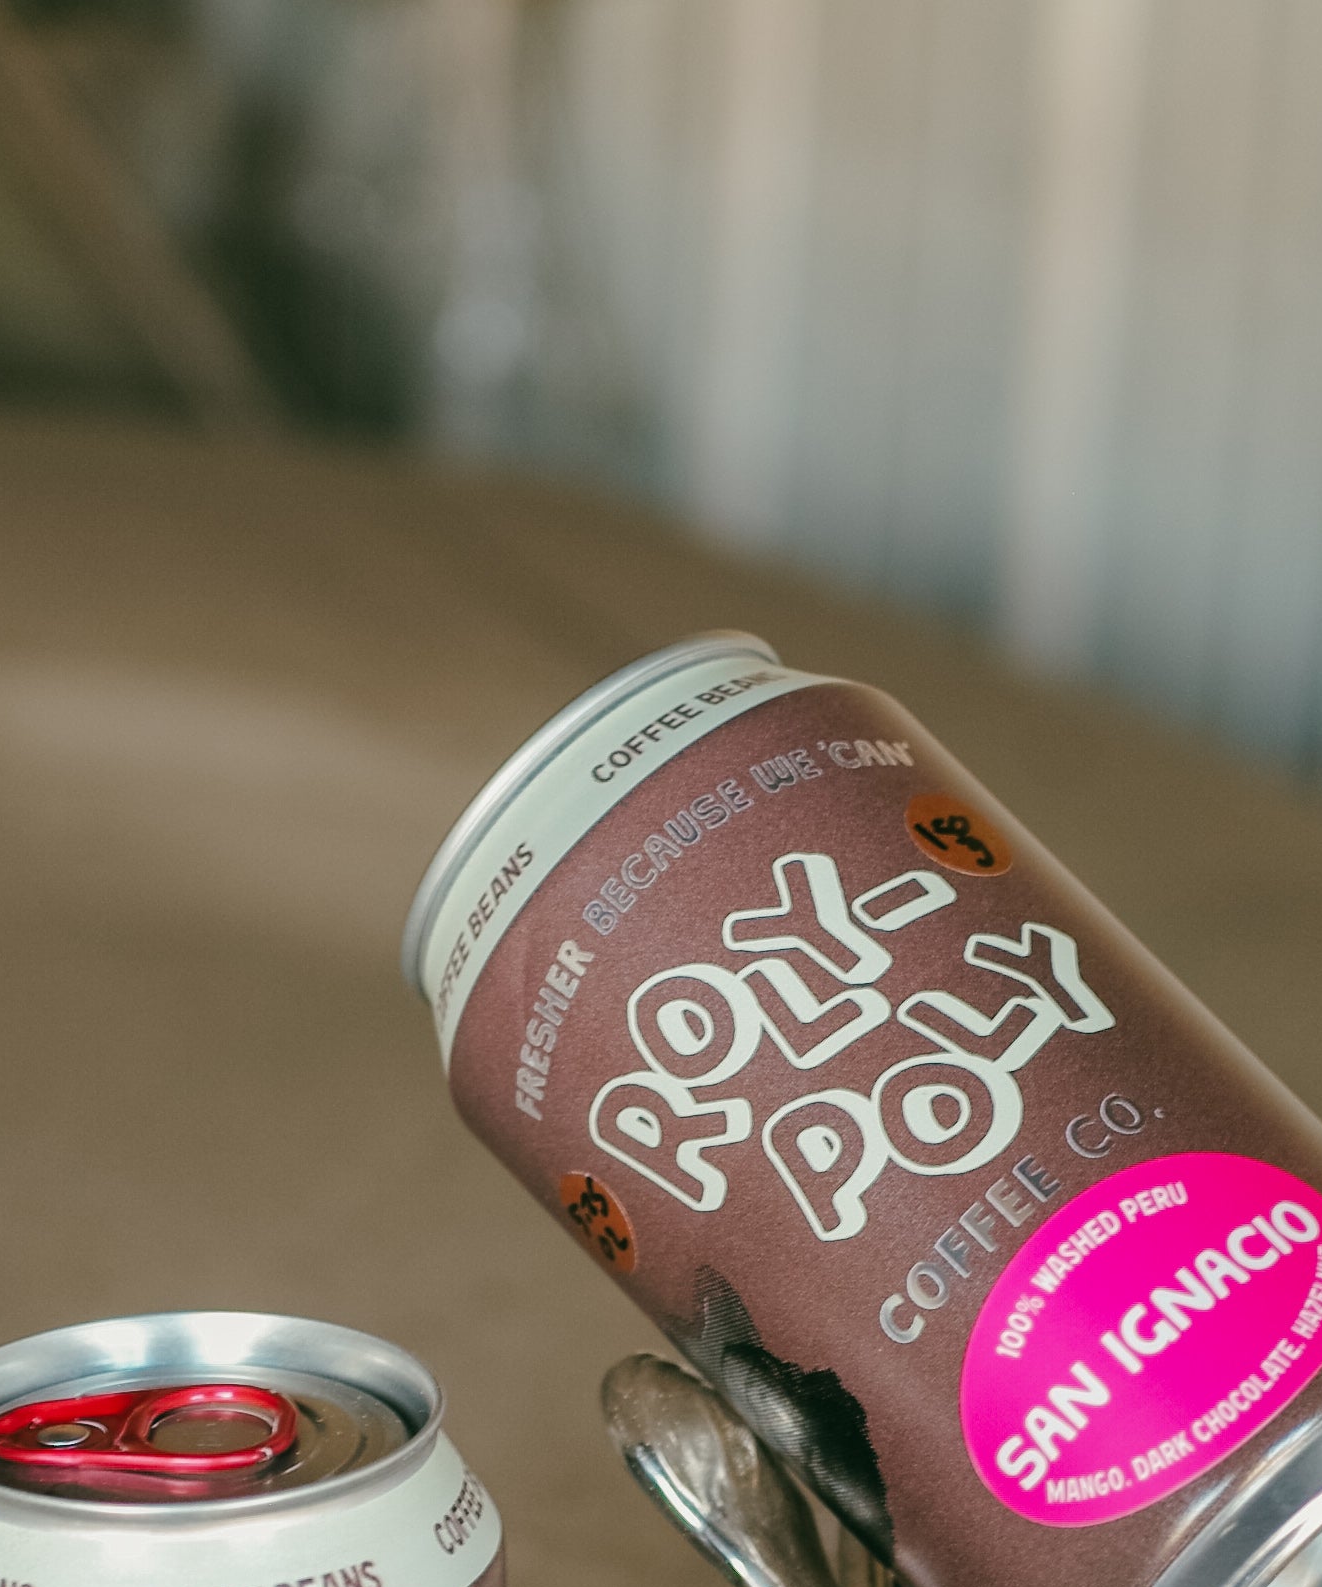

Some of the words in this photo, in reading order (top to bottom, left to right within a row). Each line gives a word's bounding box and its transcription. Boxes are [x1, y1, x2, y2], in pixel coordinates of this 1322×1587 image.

[591, 703, 705, 784] COFFEE
[467, 842, 533, 940] BEANS
[515, 939, 594, 1121] FRESHER
[582, 778, 755, 936] BECAUSE
[749, 748, 823, 794] WE
[588, 852, 957, 1212] ROLY-
[761, 922, 1117, 1241] POLY
[879, 1154, 1062, 1344] COFFEE
[1064, 1092, 1167, 1160] CO.
[995, 1294, 1045, 1359] 100%
[1030, 1209, 1122, 1293] WASHED
[1118, 1180, 1189, 1224] PERU
[995, 1360, 1111, 1491] SAN
[1099, 1199, 1322, 1376] IGNACIO
[1131, 1430, 1196, 1482] DARK
